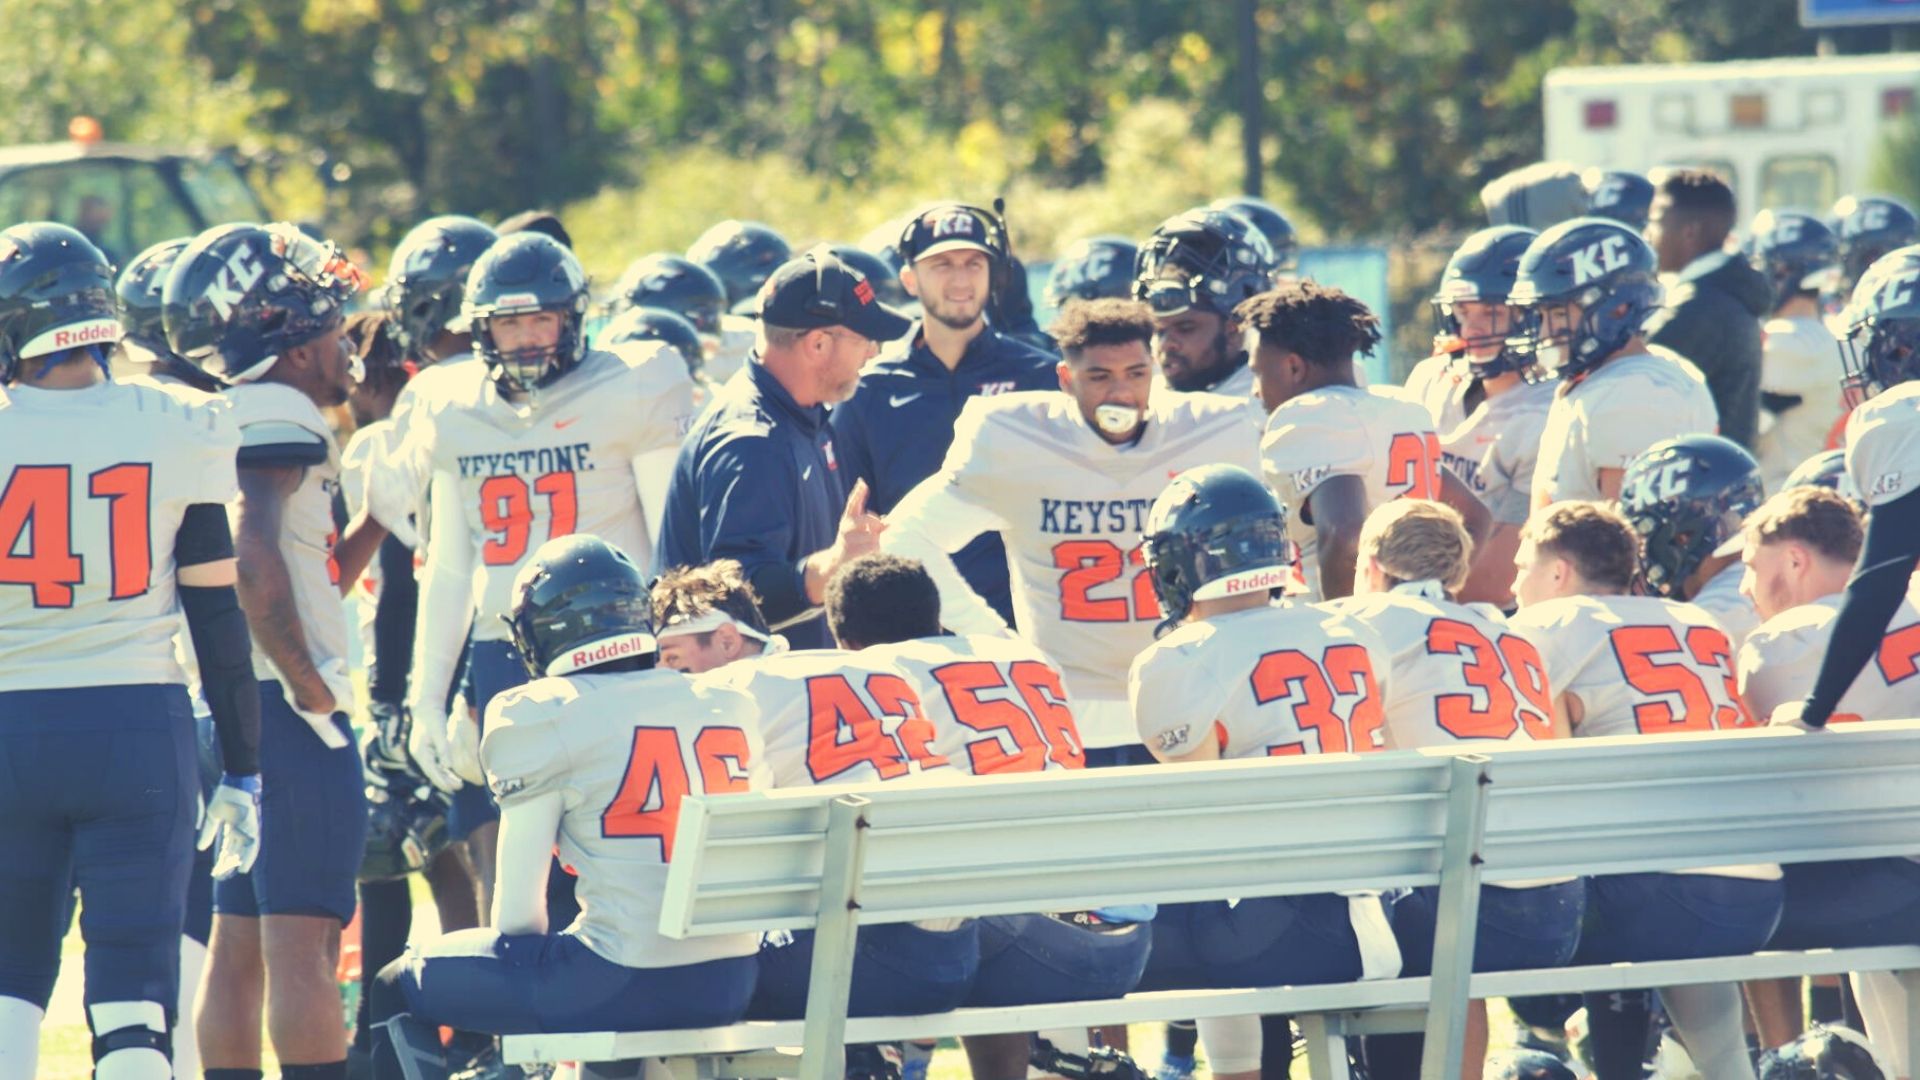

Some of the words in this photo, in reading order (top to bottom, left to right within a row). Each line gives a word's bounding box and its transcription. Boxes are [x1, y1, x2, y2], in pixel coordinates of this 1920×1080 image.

[202, 243, 265, 323] KC
[1570, 235, 1630, 286] KC
[54, 323, 118, 347] Riddell
[479, 471, 577, 566] 91
[1040, 498, 1157, 534] KEYST
[1627, 459, 1692, 512] KC
[0, 463, 152, 608] 41
[1226, 571, 1287, 593] Riddell
[572, 637, 642, 667] Riddell
[1425, 617, 1555, 741] 39
[1609, 625, 1757, 734] 53
[806, 673, 950, 784] 42
[929, 660, 1086, 775] 56
[1250, 643, 1386, 757] 32
